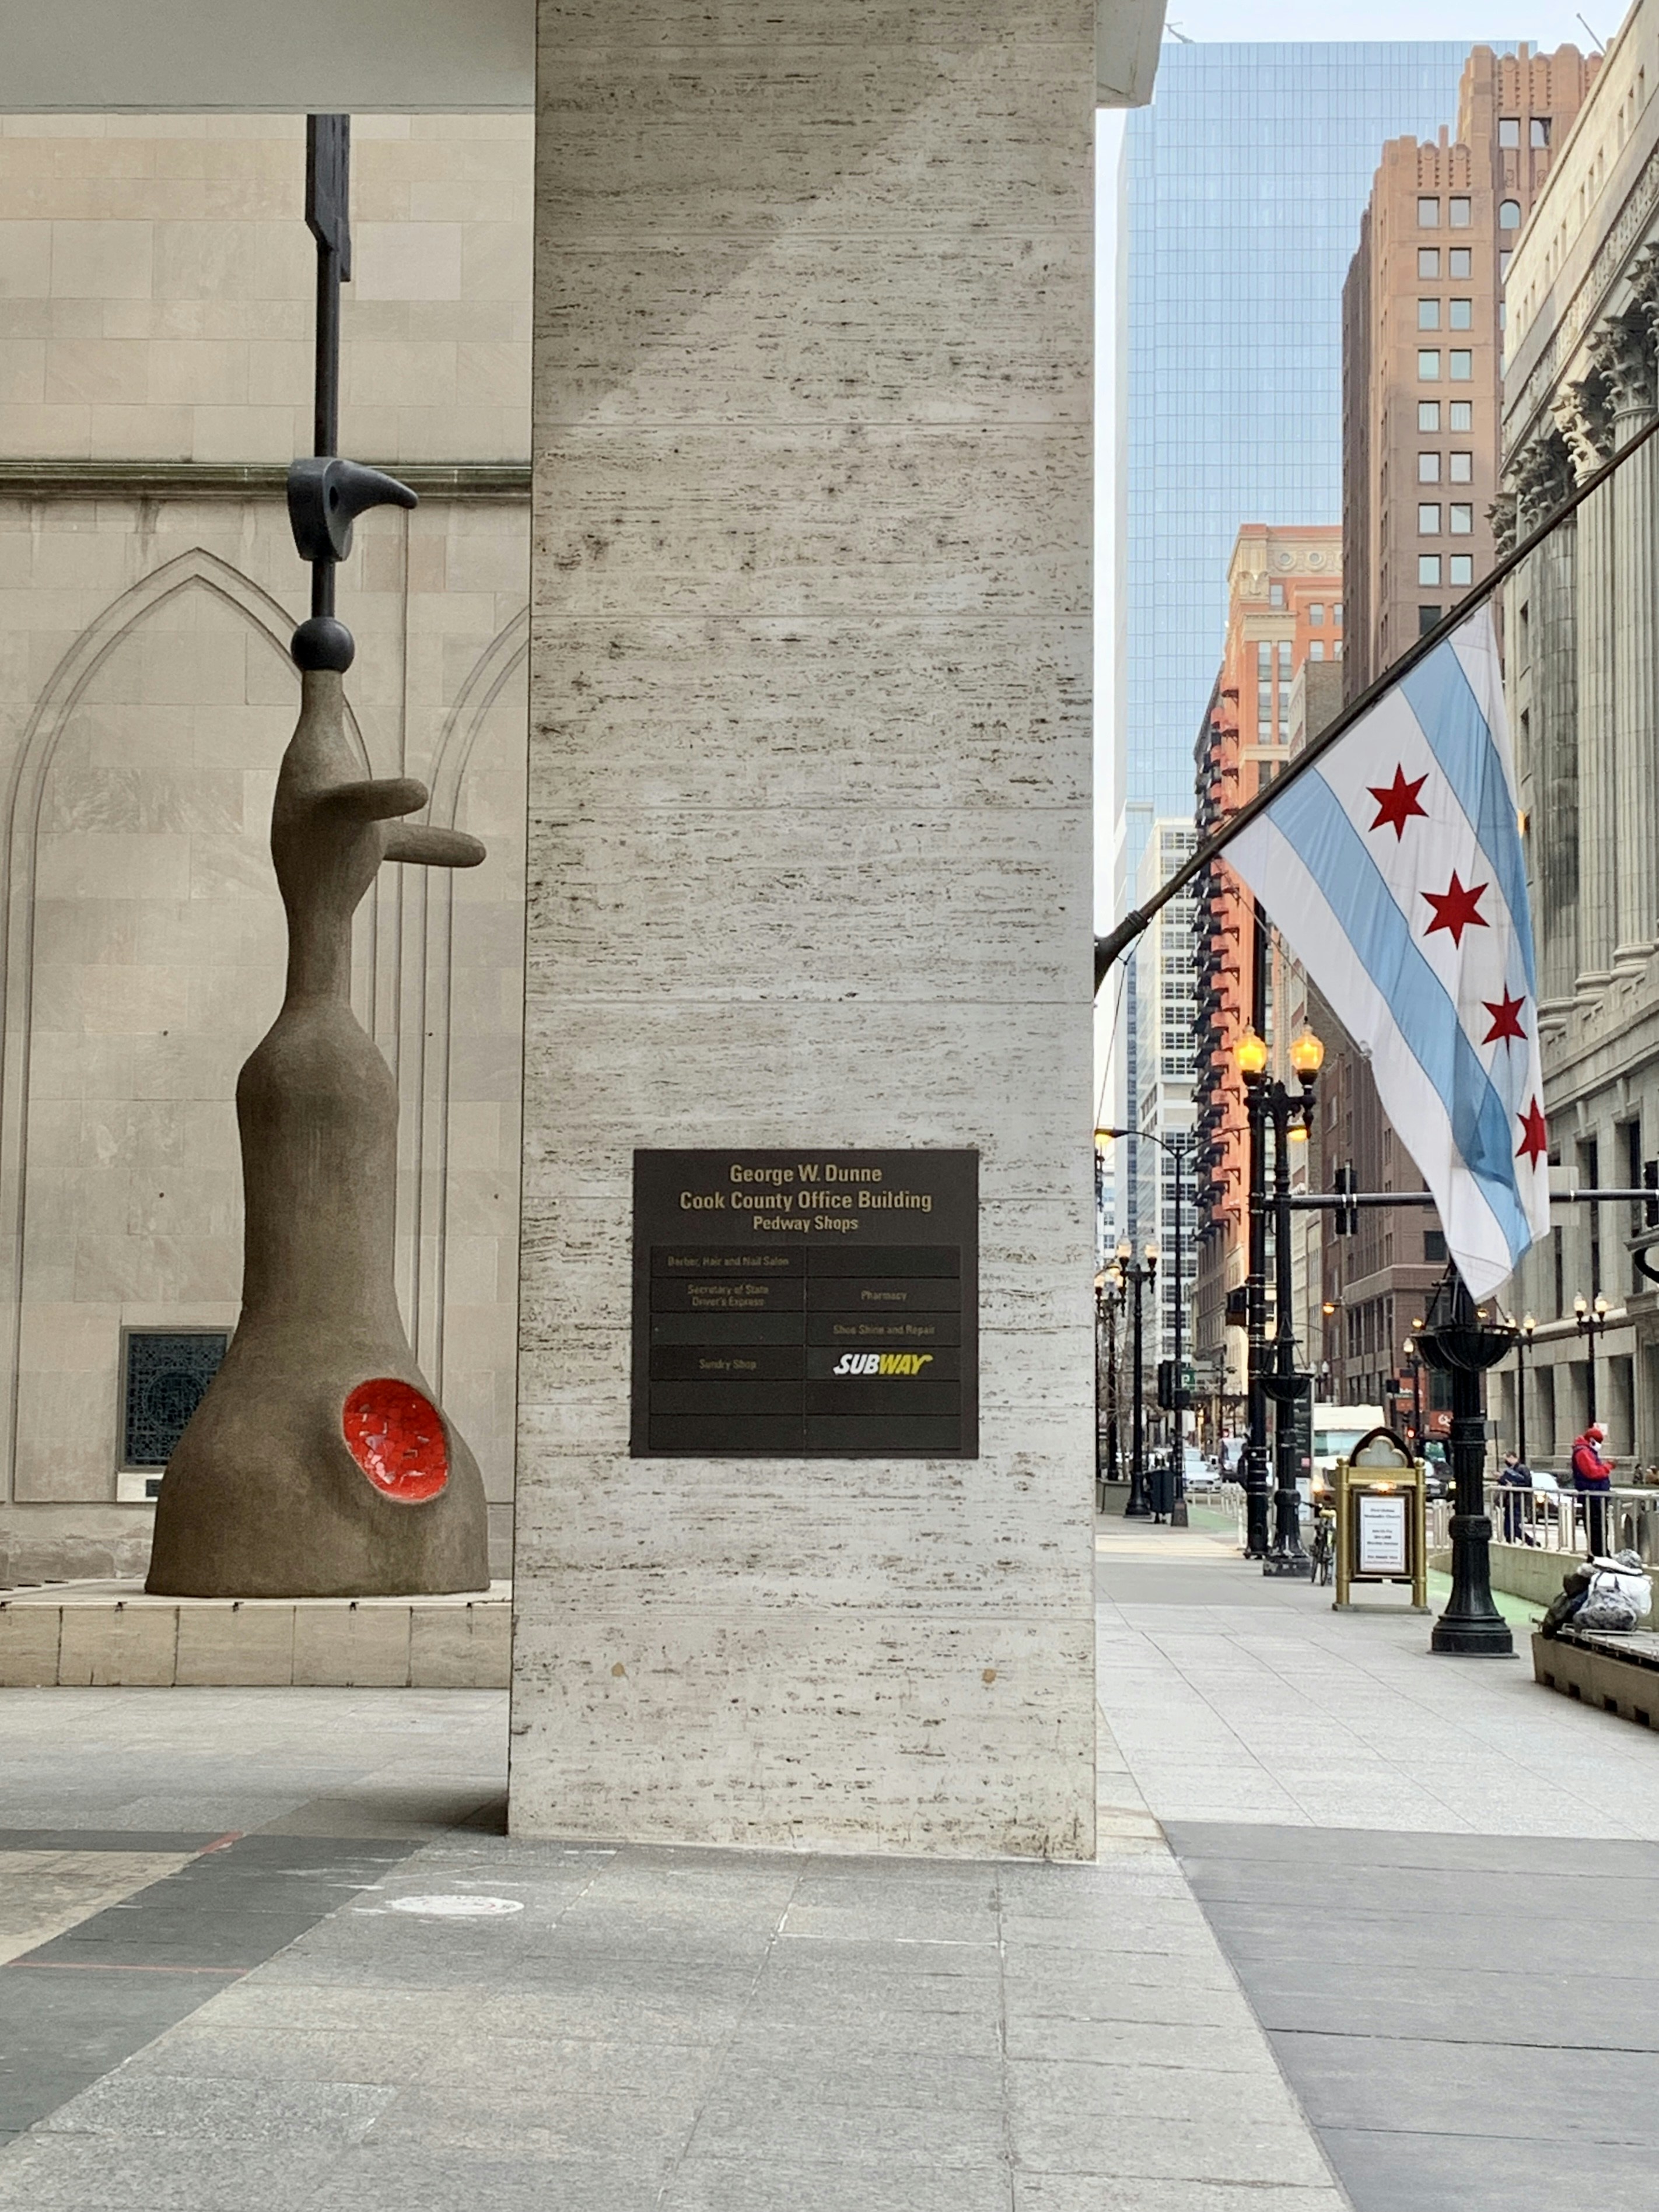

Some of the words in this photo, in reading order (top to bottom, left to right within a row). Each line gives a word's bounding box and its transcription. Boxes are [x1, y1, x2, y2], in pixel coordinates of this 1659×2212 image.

[730, 1165, 794, 1186] George
[798, 1165, 821, 1182] W.
[825, 1165, 882, 1182] Dunne
[680, 1191, 724, 1210] Cook
[731, 1191, 793, 1212] County
[798, 1191, 852, 1209] Office
[858, 1191, 932, 1212] Building
[753, 1217, 810, 1233] Pedway
[815, 1216, 859, 1233] Shops
[702, 1256, 722, 1266] Hair
[724, 1256, 741, 1266] and
[743, 1256, 761, 1266] Nail
[763, 1256, 789, 1266] Salon
[687, 1284, 732, 1295] Secretary
[734, 1284, 743, 1293] of
[746, 1284, 769, 1295] State
[860, 1289, 908, 1301] Pharmacy
[728, 1296, 765, 1307] Express
[833, 1324, 856, 1335] Shoe
[859, 1324, 884, 1335] Shine
[886, 1325, 904, 1334] and
[905, 1324, 936, 1337] Repair
[699, 1358, 730, 1371] Sundry
[733, 1358, 757, 1371] Shop
[833, 1354, 933, 1375] SUBWAY
